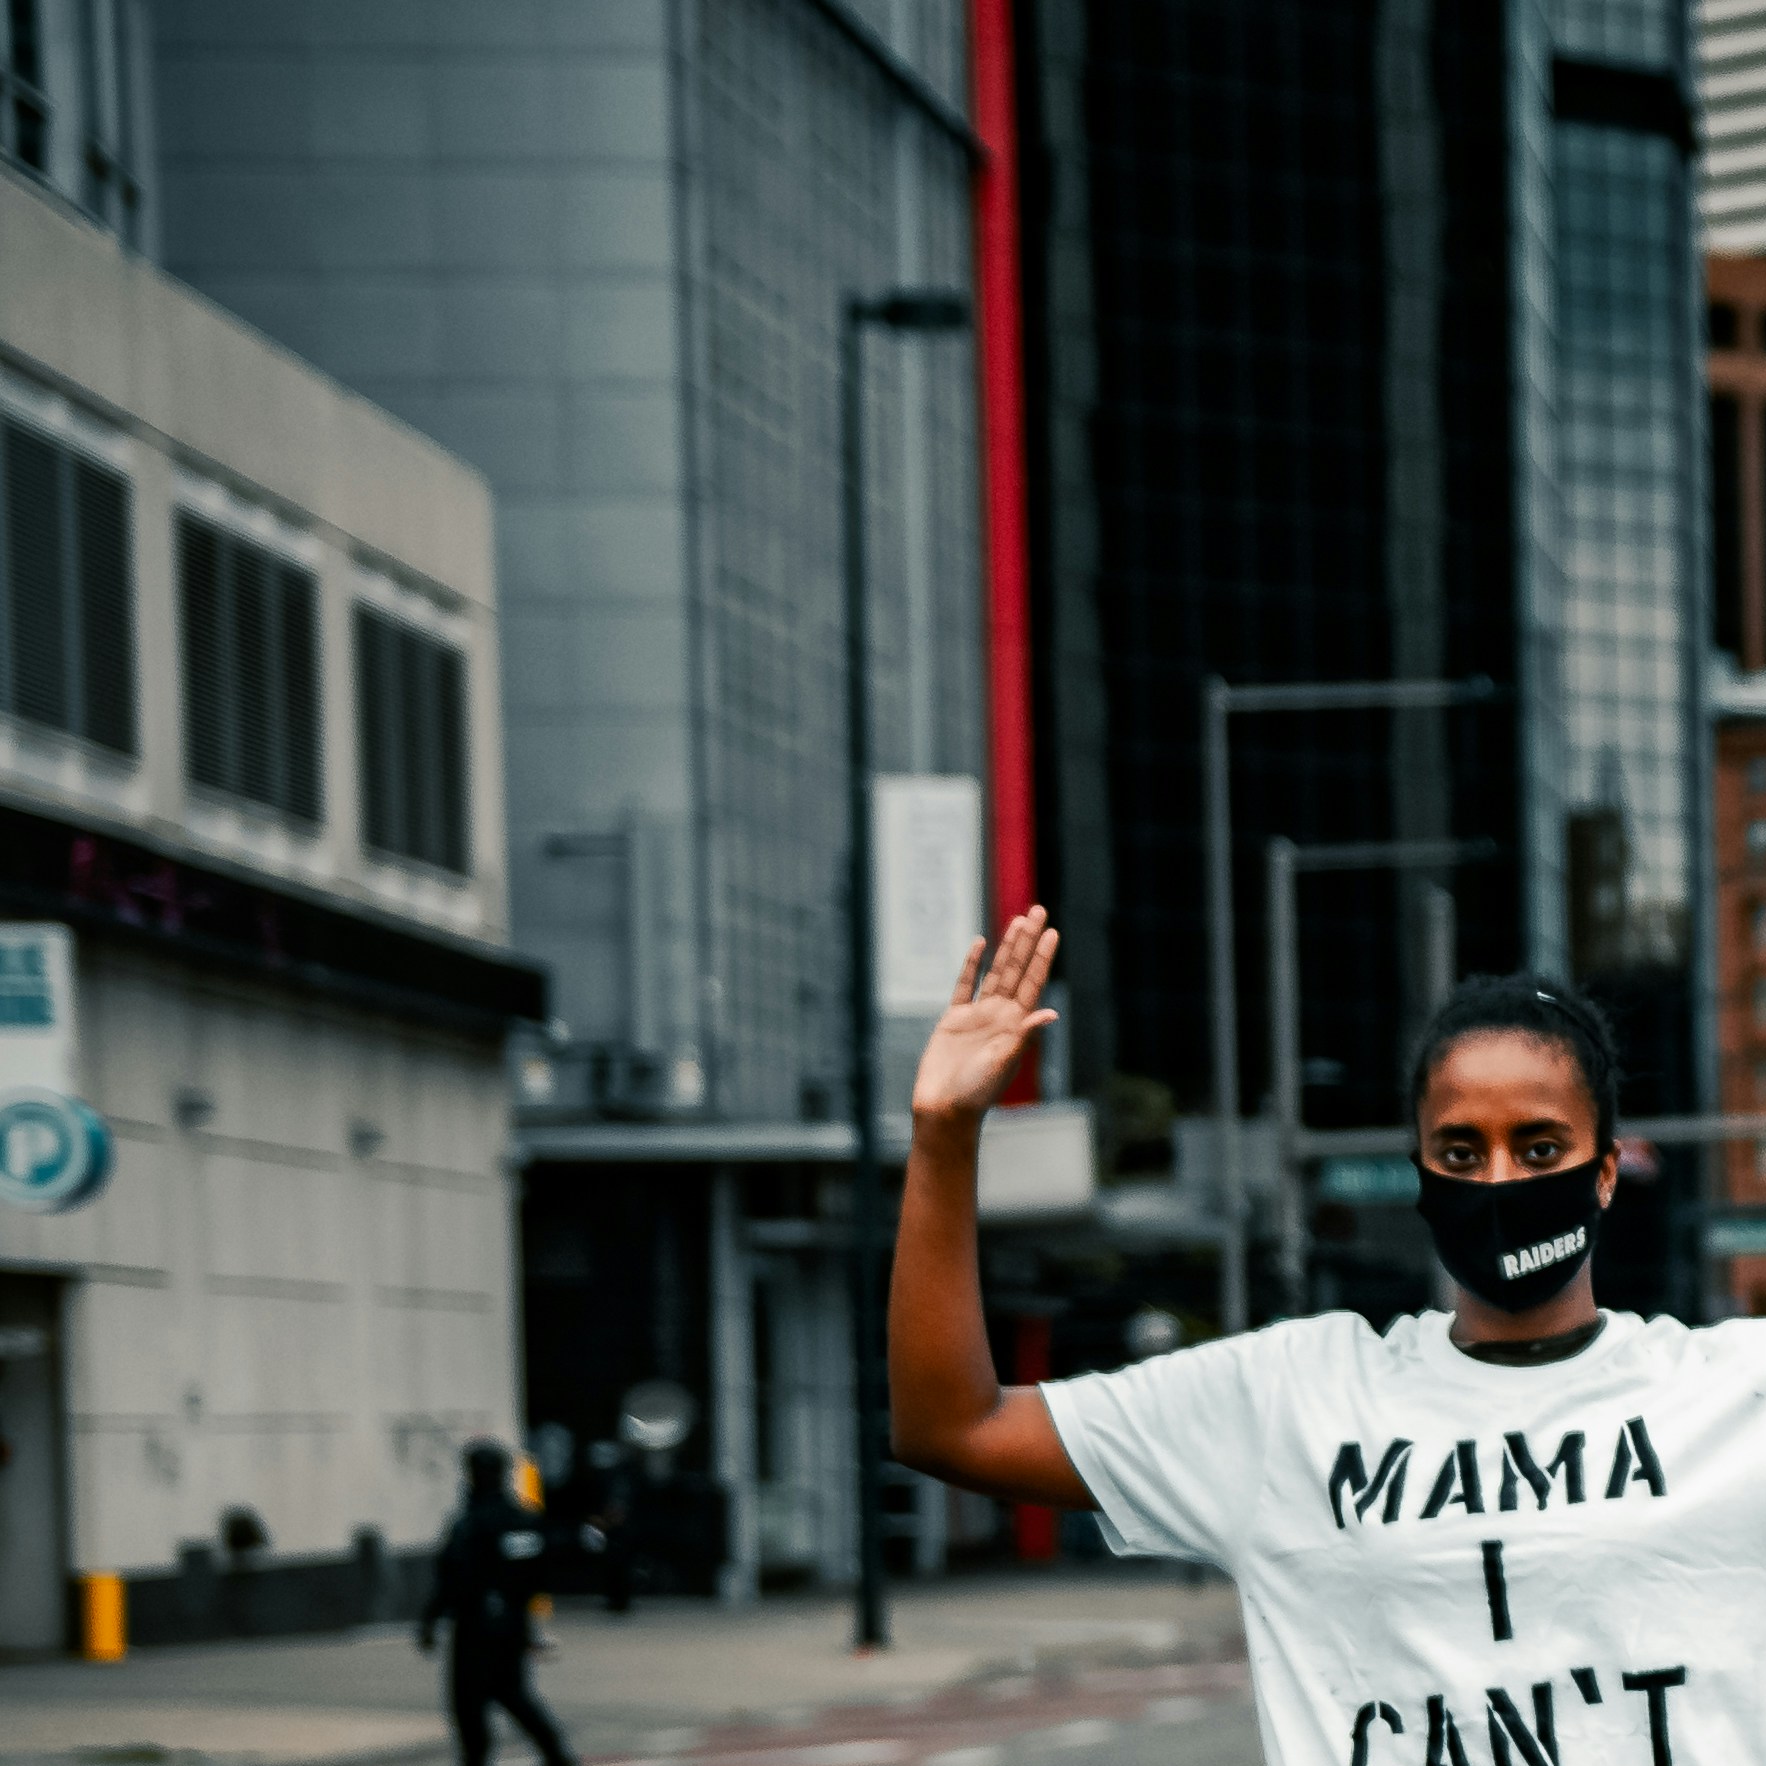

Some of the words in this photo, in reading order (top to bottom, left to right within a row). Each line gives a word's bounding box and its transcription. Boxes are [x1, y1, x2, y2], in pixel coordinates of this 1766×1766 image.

[1502, 1226, 1587, 1280] RAIDERS
[1327, 1416, 1668, 1530] MAMA
[1480, 1540, 1512, 1641] I
